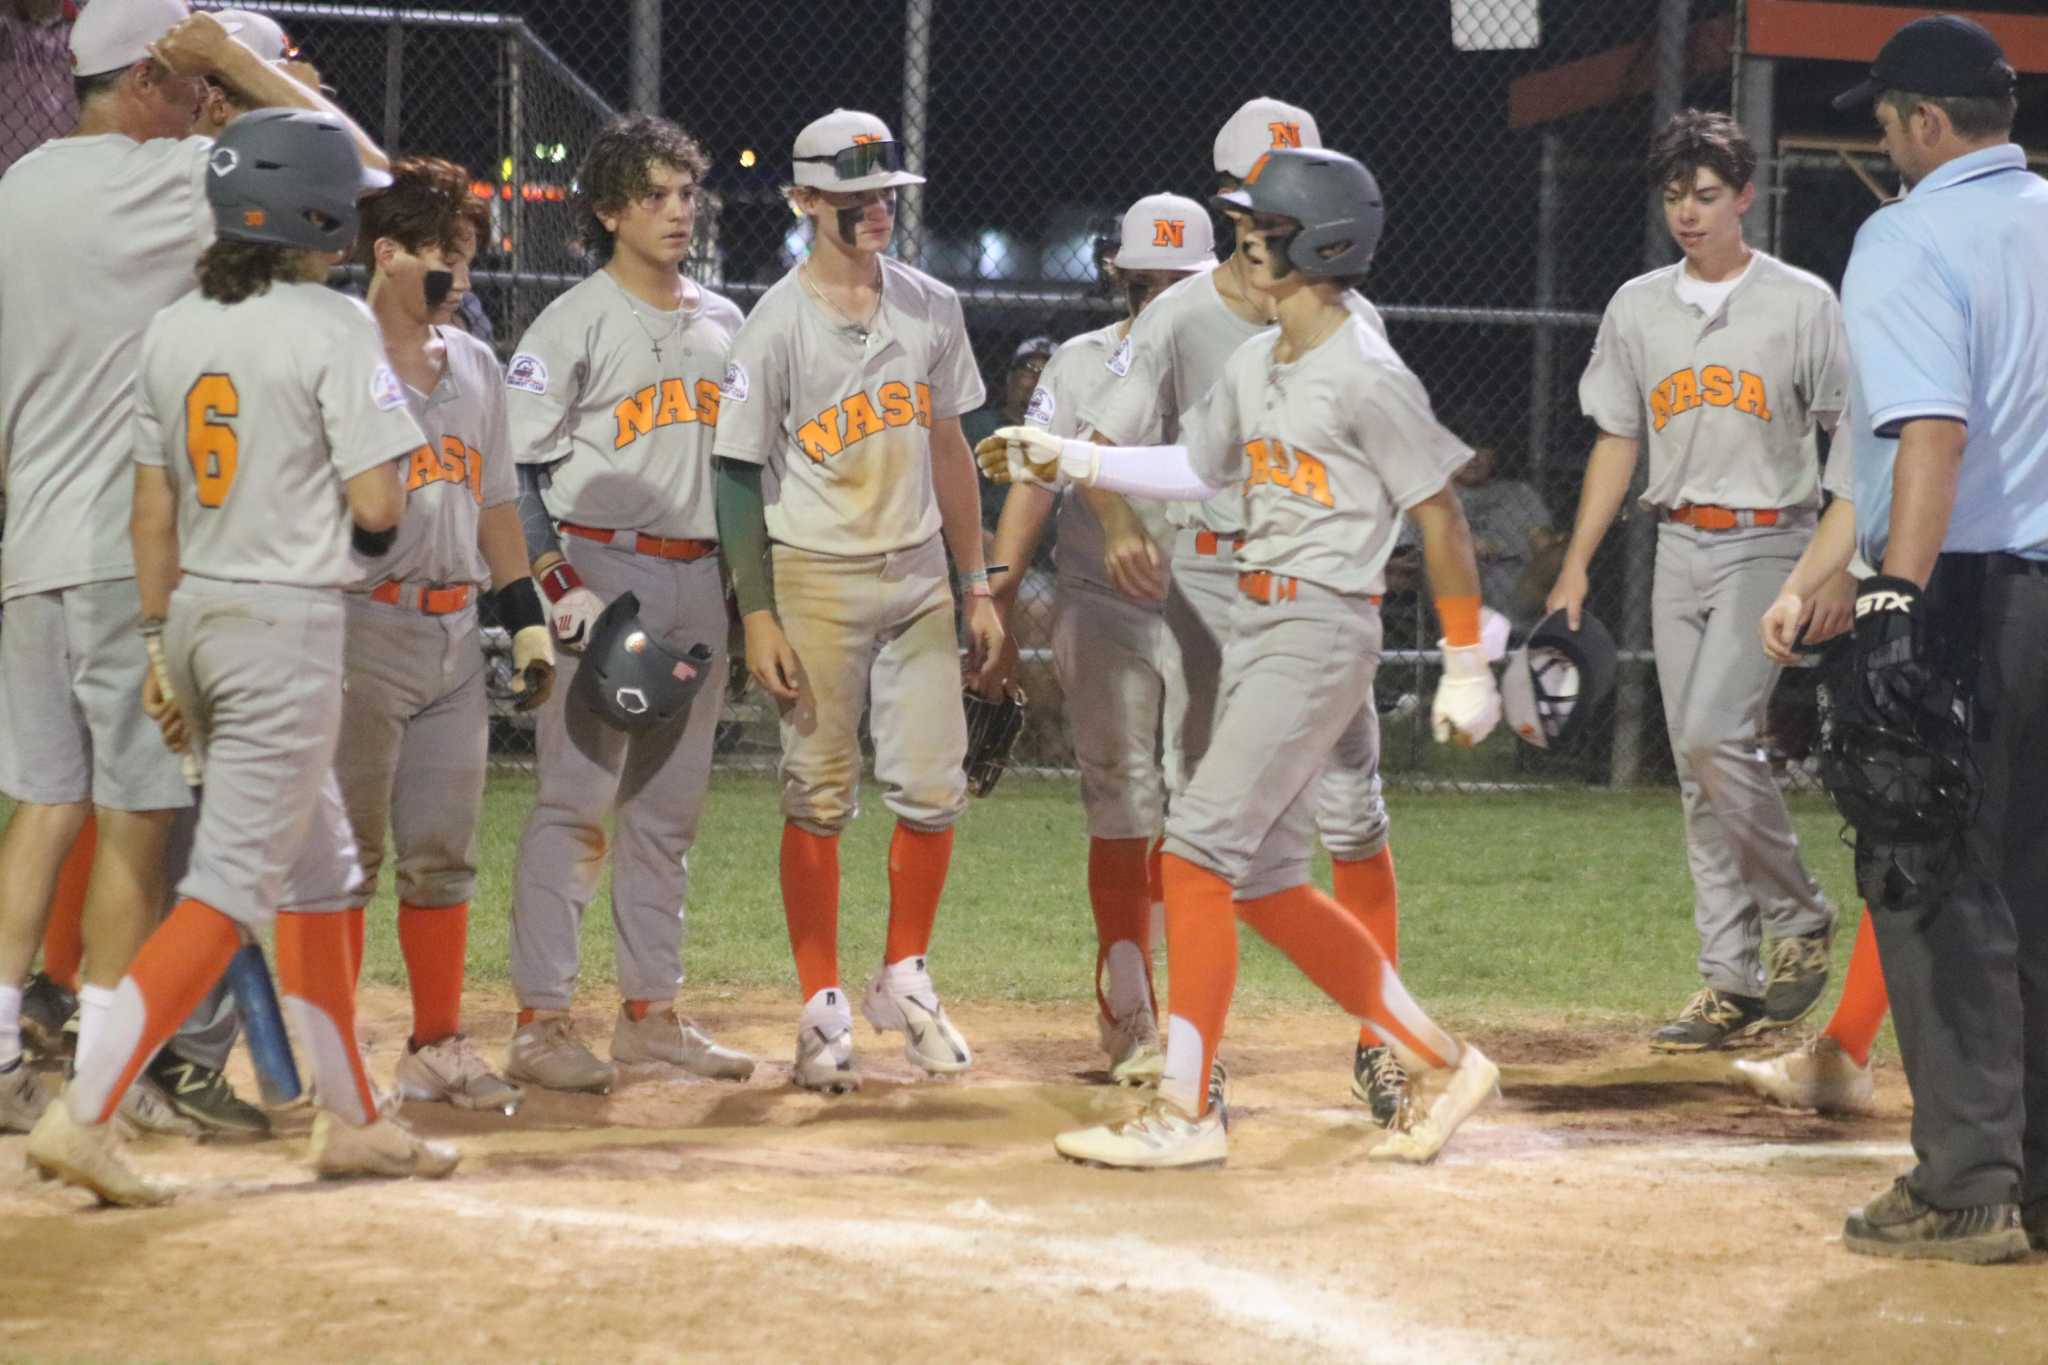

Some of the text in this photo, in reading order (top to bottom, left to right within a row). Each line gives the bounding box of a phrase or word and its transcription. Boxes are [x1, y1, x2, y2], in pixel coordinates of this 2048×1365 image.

[1268, 121, 1302, 149] N
[1152, 219, 1184, 248] N
[613, 377, 720, 450] NAS
[1649, 364, 1772, 433] NASA
[185, 372, 239, 509] 6
[1856, 590, 1914, 619] STX
